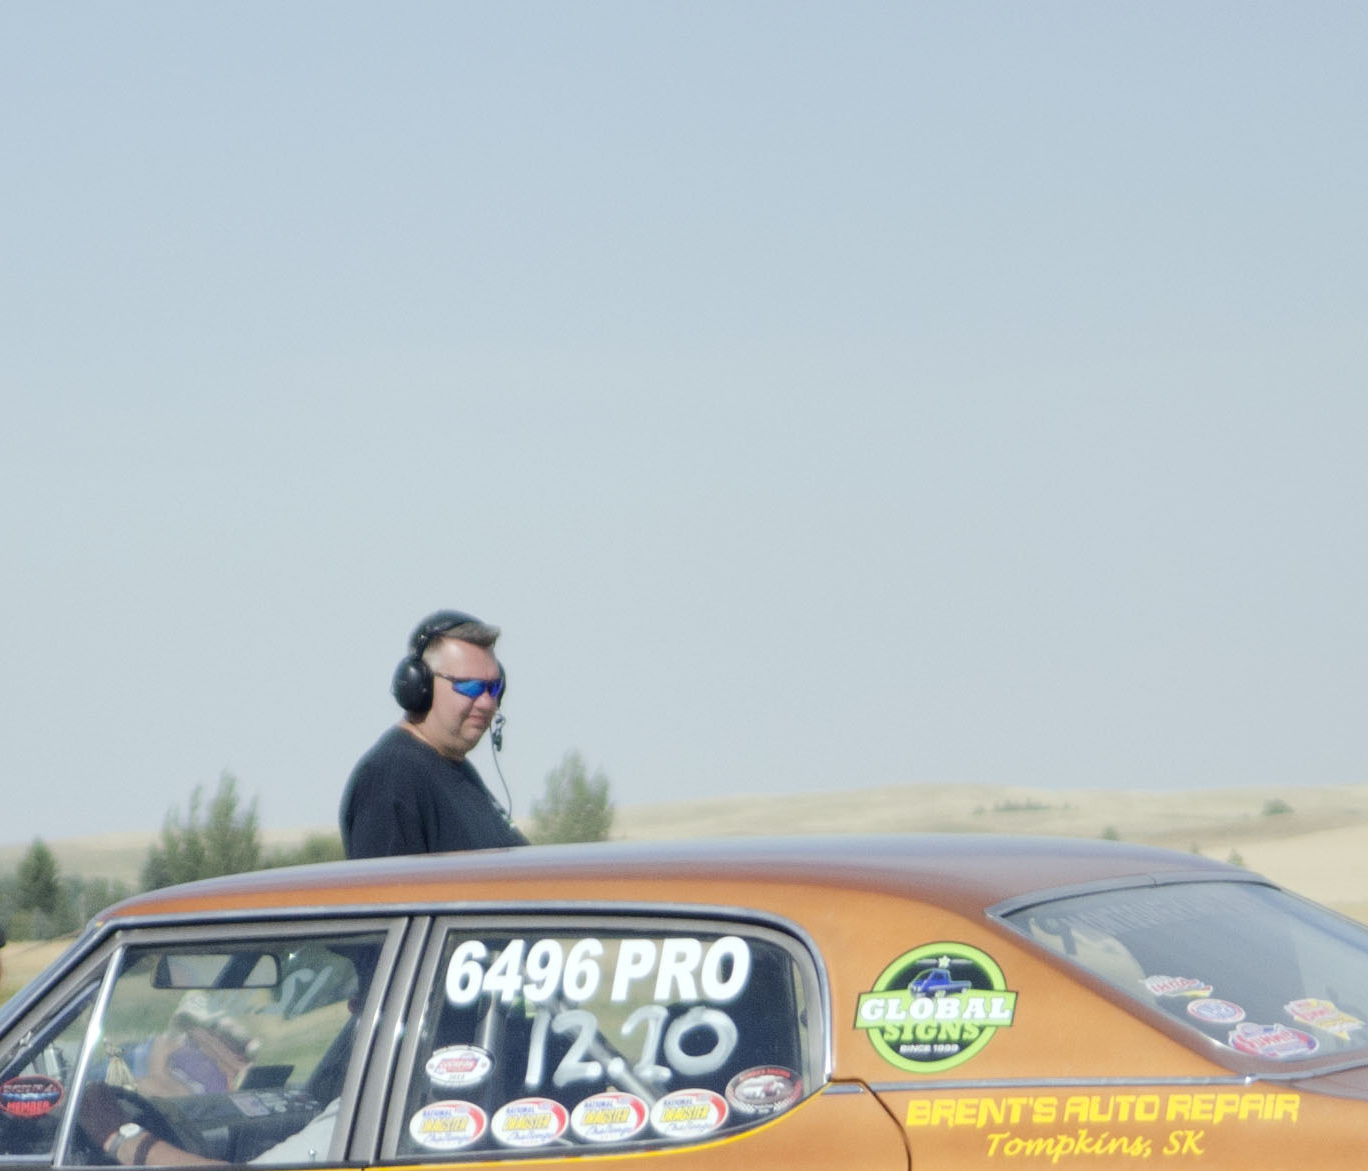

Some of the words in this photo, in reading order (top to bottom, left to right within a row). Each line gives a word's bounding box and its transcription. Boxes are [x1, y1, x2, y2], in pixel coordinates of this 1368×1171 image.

[444, 938, 604, 1004] 6496
[609, 936, 752, 1003] PRO
[860, 997, 1012, 1020] GLOBAL
[882, 1021, 980, 1041] SIGNS
[906, 1096, 1058, 1128] BRENT'S
[1064, 1095, 1160, 1122] AUTO
[1166, 1093, 1301, 1125] REPAIR
[986, 1129, 1153, 1164] Tompkins,
[1162, 1130, 1206, 1155] SK
